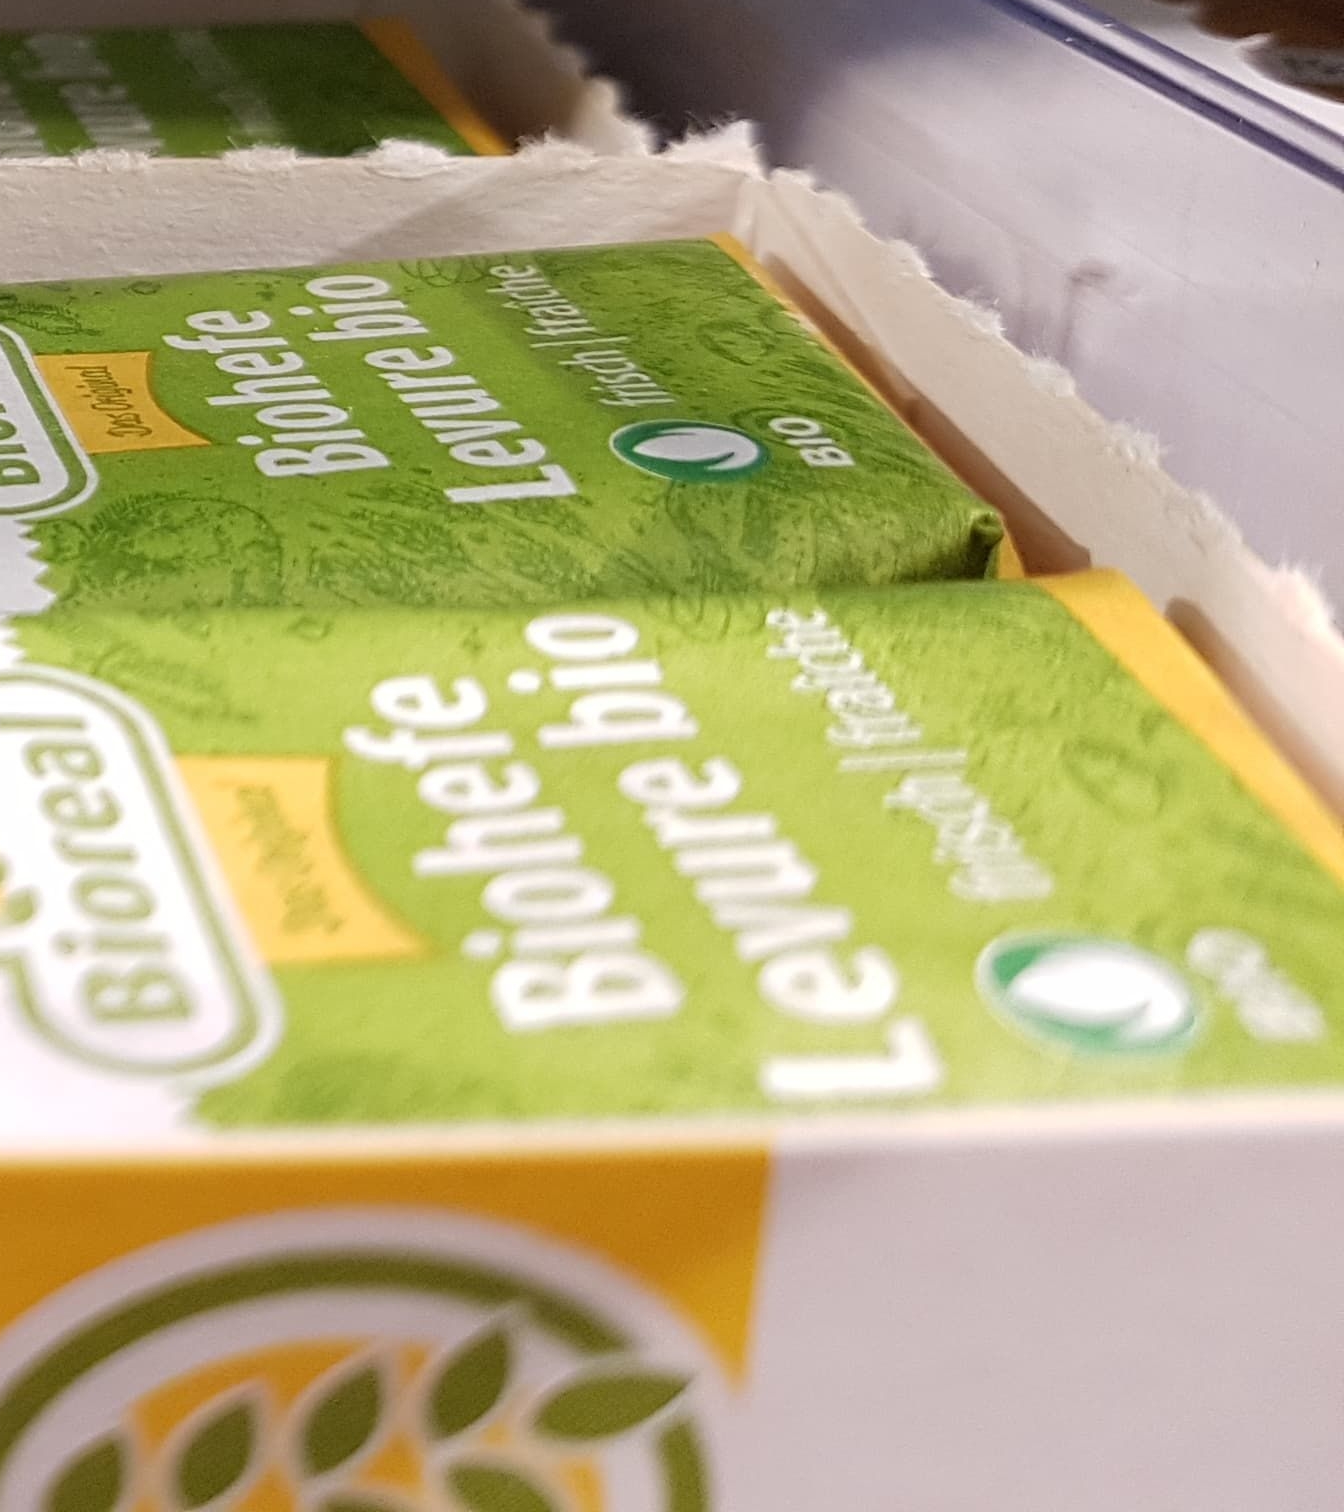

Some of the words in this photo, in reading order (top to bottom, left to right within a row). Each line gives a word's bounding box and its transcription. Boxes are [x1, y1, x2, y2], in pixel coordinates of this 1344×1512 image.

[288, 274, 430, 342] bio
[487, 264, 597, 339] fraîche
[162, 309, 390, 477] Biohefe
[364, 344, 579, 504] Levure
[557, 347, 676, 408] frisch
[768, 416, 857, 469] BIO
[508, 612, 700, 750] bio
[342, 674, 687, 1032] Biohefe
[618, 755, 942, 1102] Levure
